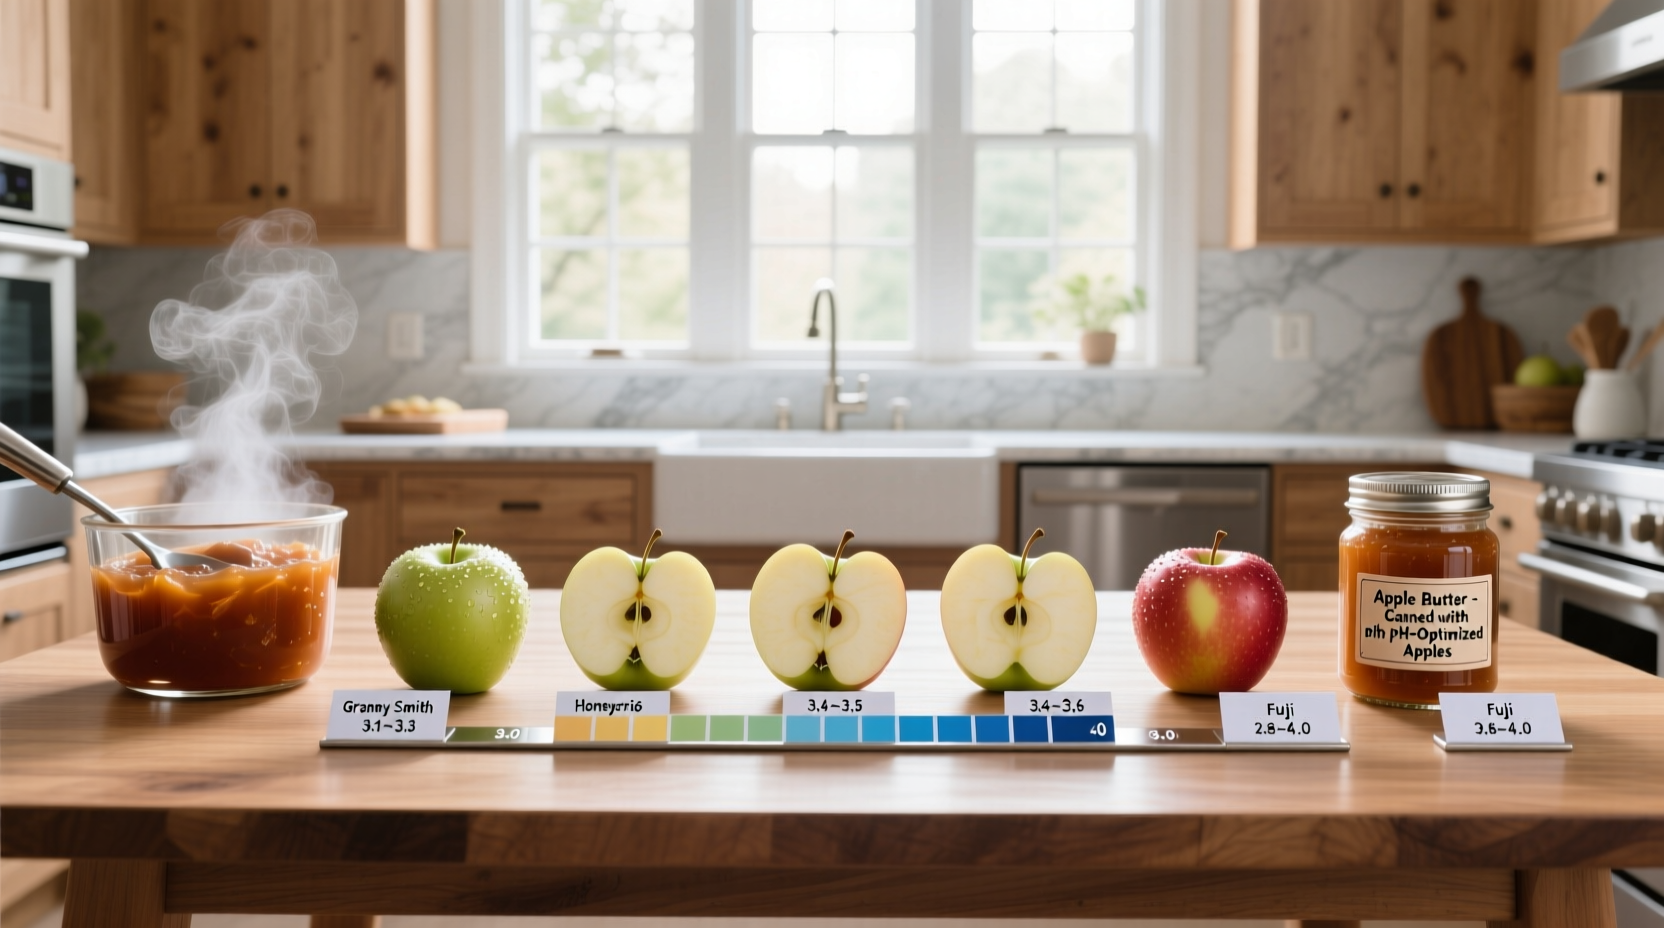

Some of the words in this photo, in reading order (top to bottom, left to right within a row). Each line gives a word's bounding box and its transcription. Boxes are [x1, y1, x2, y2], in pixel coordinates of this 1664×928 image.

[1374, 589, 1416, 609] Apple
[1421, 591, 1468, 606] Butter
[1403, 643, 1452, 661] Apples
[343, 700, 391, 717] Granny
[393, 700, 434, 714] Smith
[1267, 702, 1294, 720] Fuji
[1487, 702, 1513, 720] Fuji
